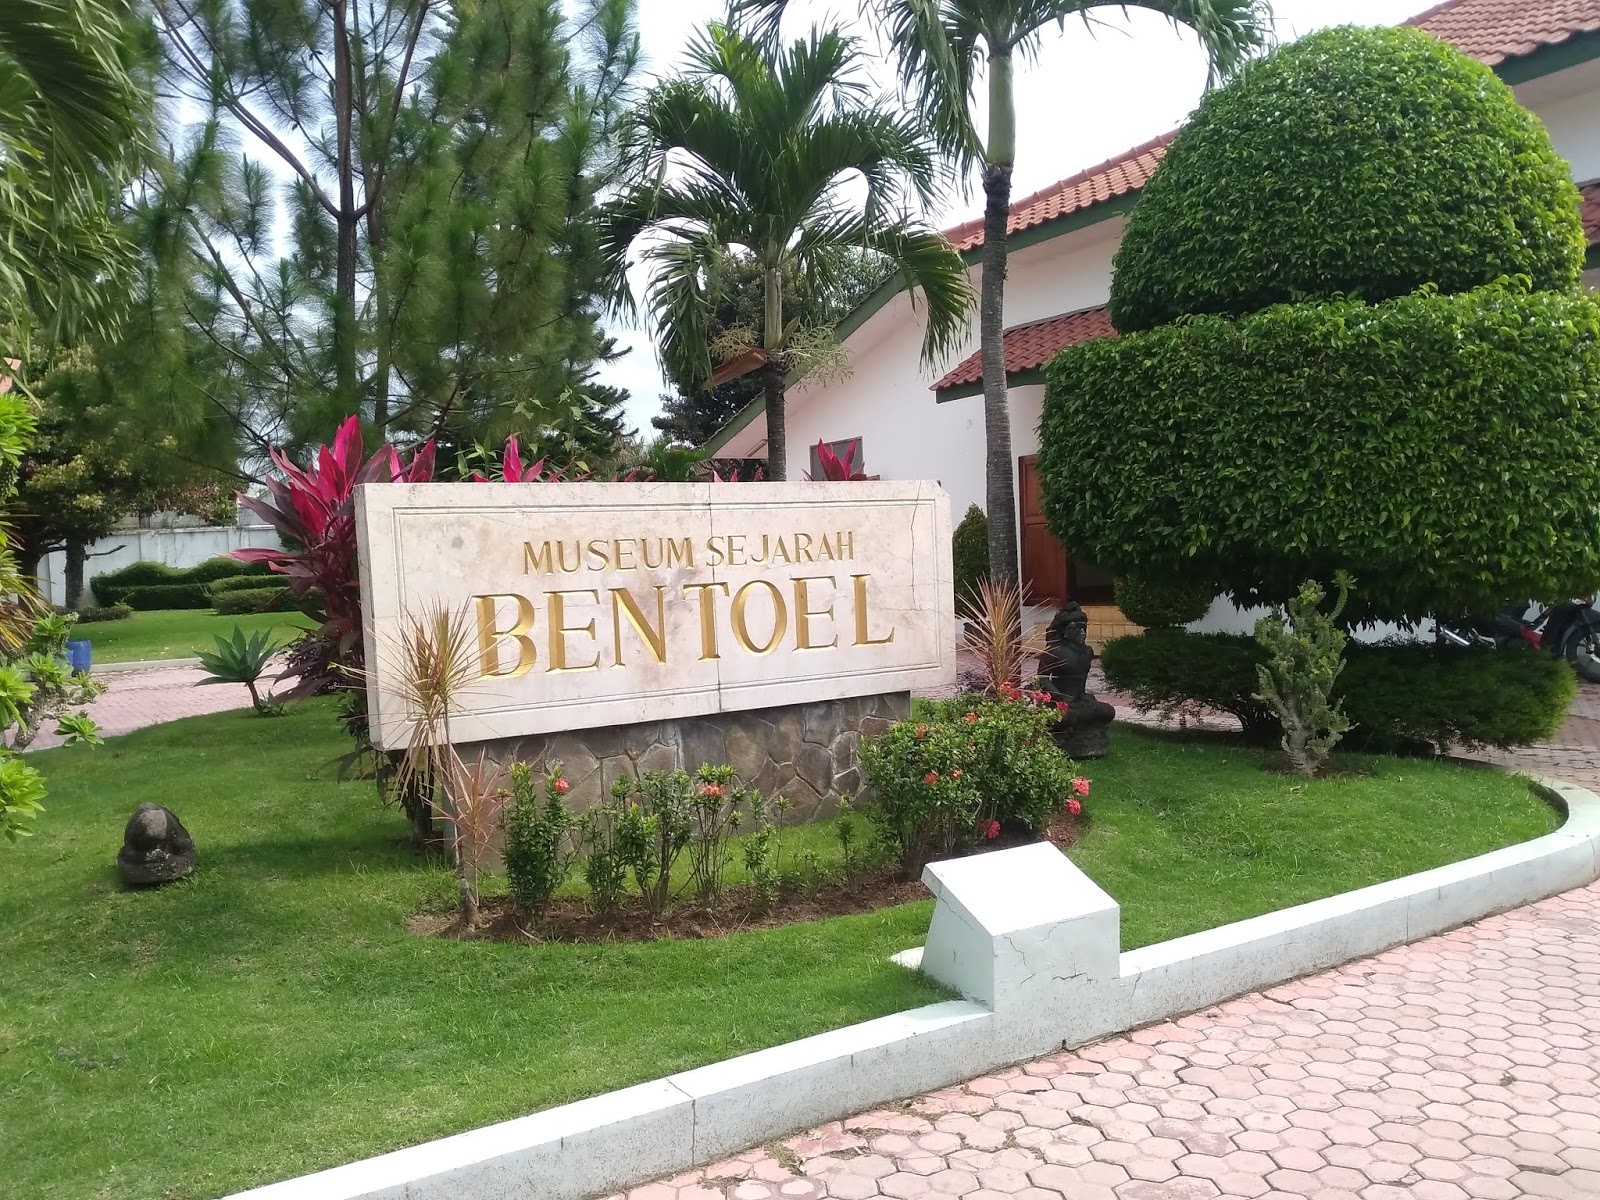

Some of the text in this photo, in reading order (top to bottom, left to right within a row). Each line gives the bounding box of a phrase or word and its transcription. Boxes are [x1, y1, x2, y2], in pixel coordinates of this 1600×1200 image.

[523, 531, 855, 576] MUSEUM SEJARAH
[472, 574, 895, 679] BENTOEL
